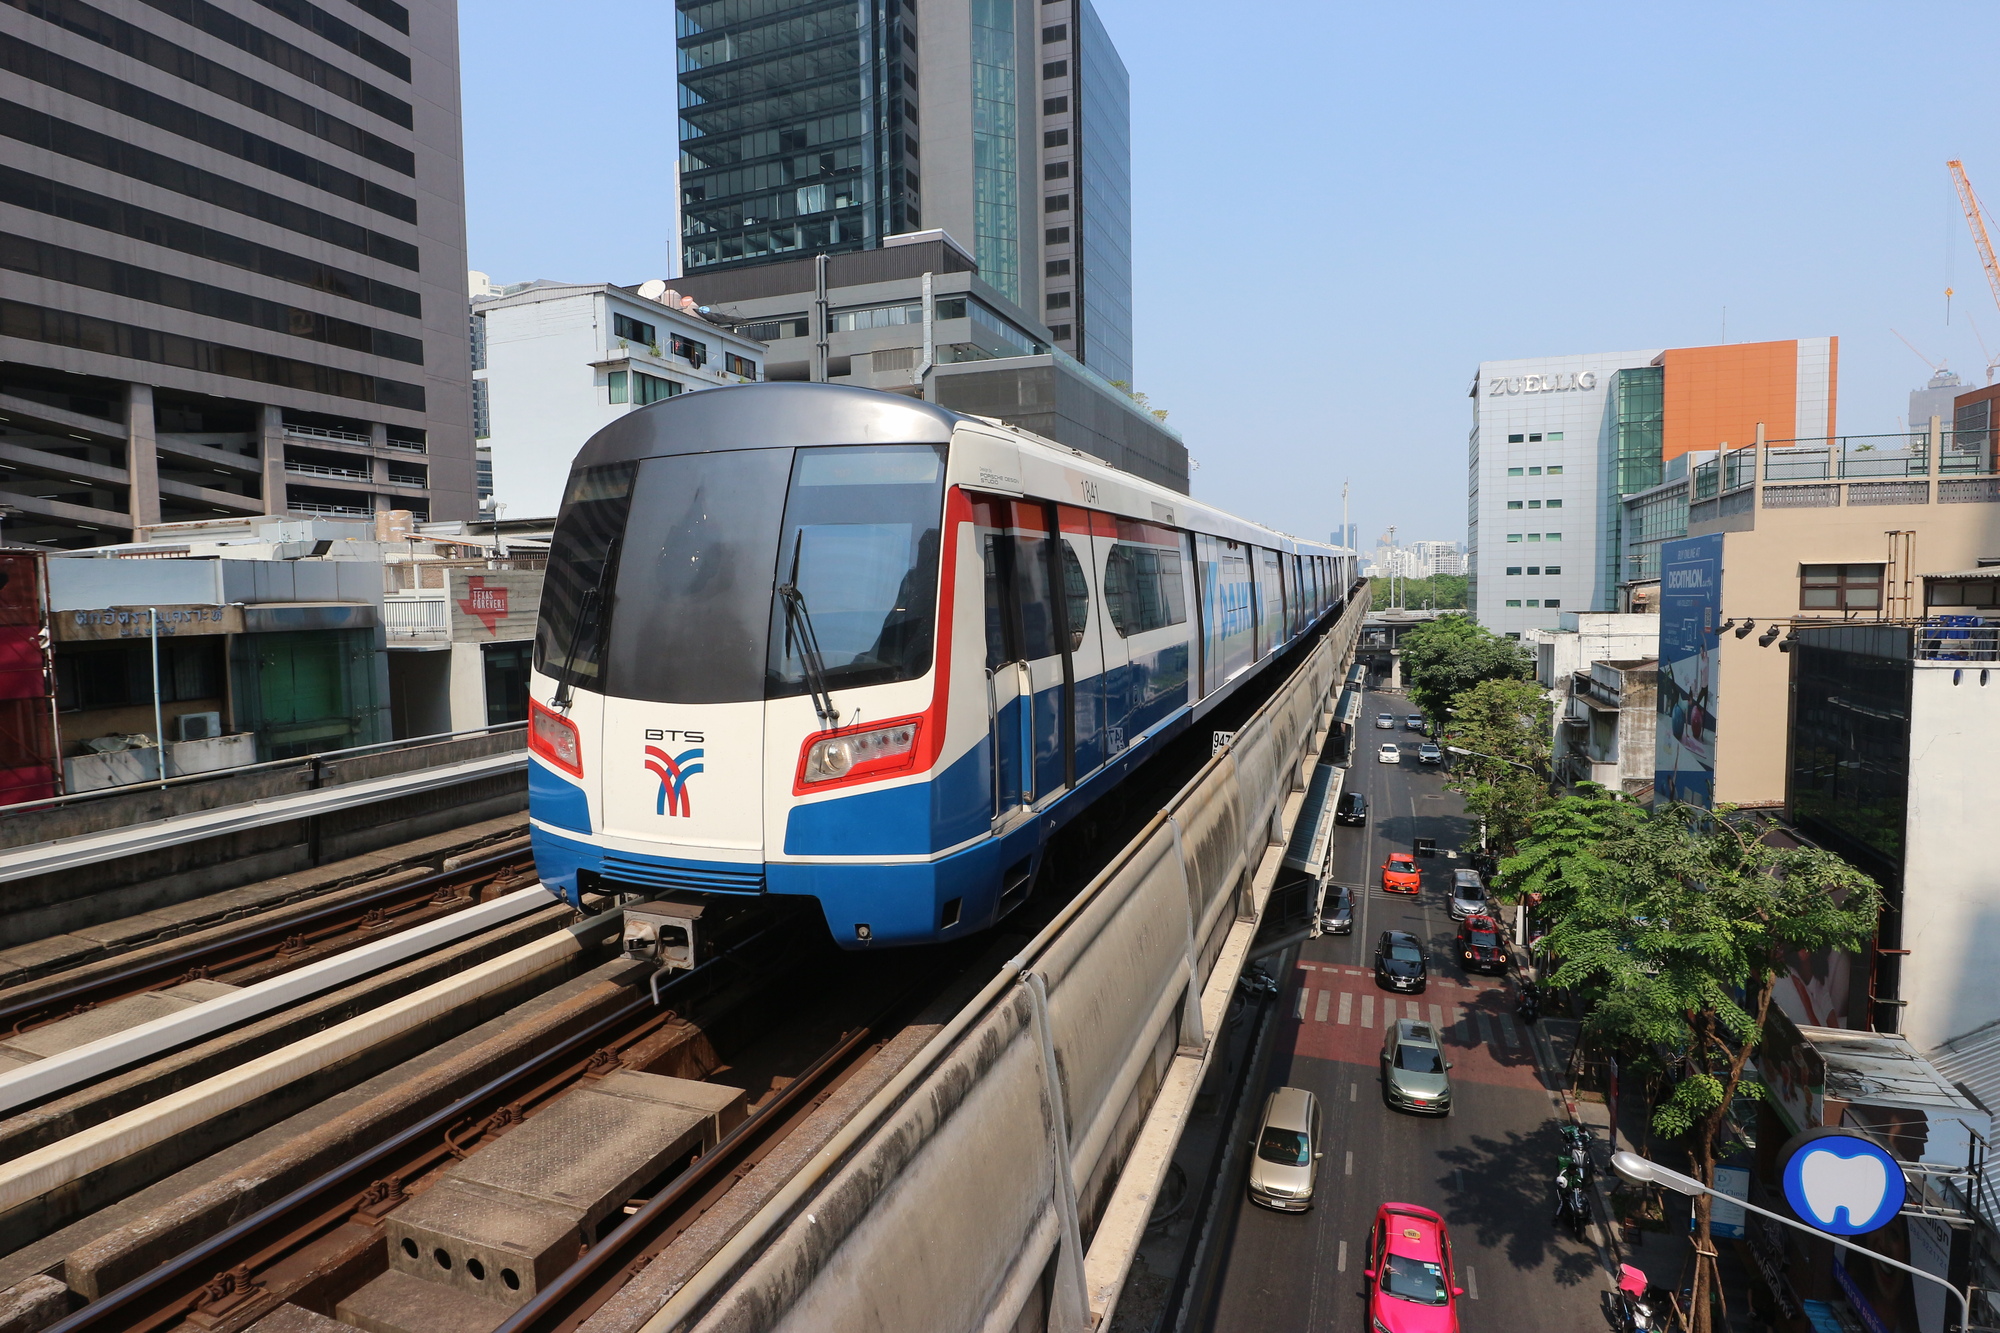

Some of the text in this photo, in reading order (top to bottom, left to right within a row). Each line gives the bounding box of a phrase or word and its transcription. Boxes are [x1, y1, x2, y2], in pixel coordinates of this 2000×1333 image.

[1489, 370, 1597, 397] ZUELLIG
[980, 472, 1019, 484] PORSCHE DESIGN
[980, 477, 998, 485] STUDIO
[1081, 480, 1100, 504] 1841
[473, 591, 493, 600] TEXAS
[473, 599, 504, 609] FOREVER!
[1220, 582, 1263, 641] DAIKIN
[645, 729, 705, 743] BTS
[1726, 1189, 1747, 1198] Clinic
